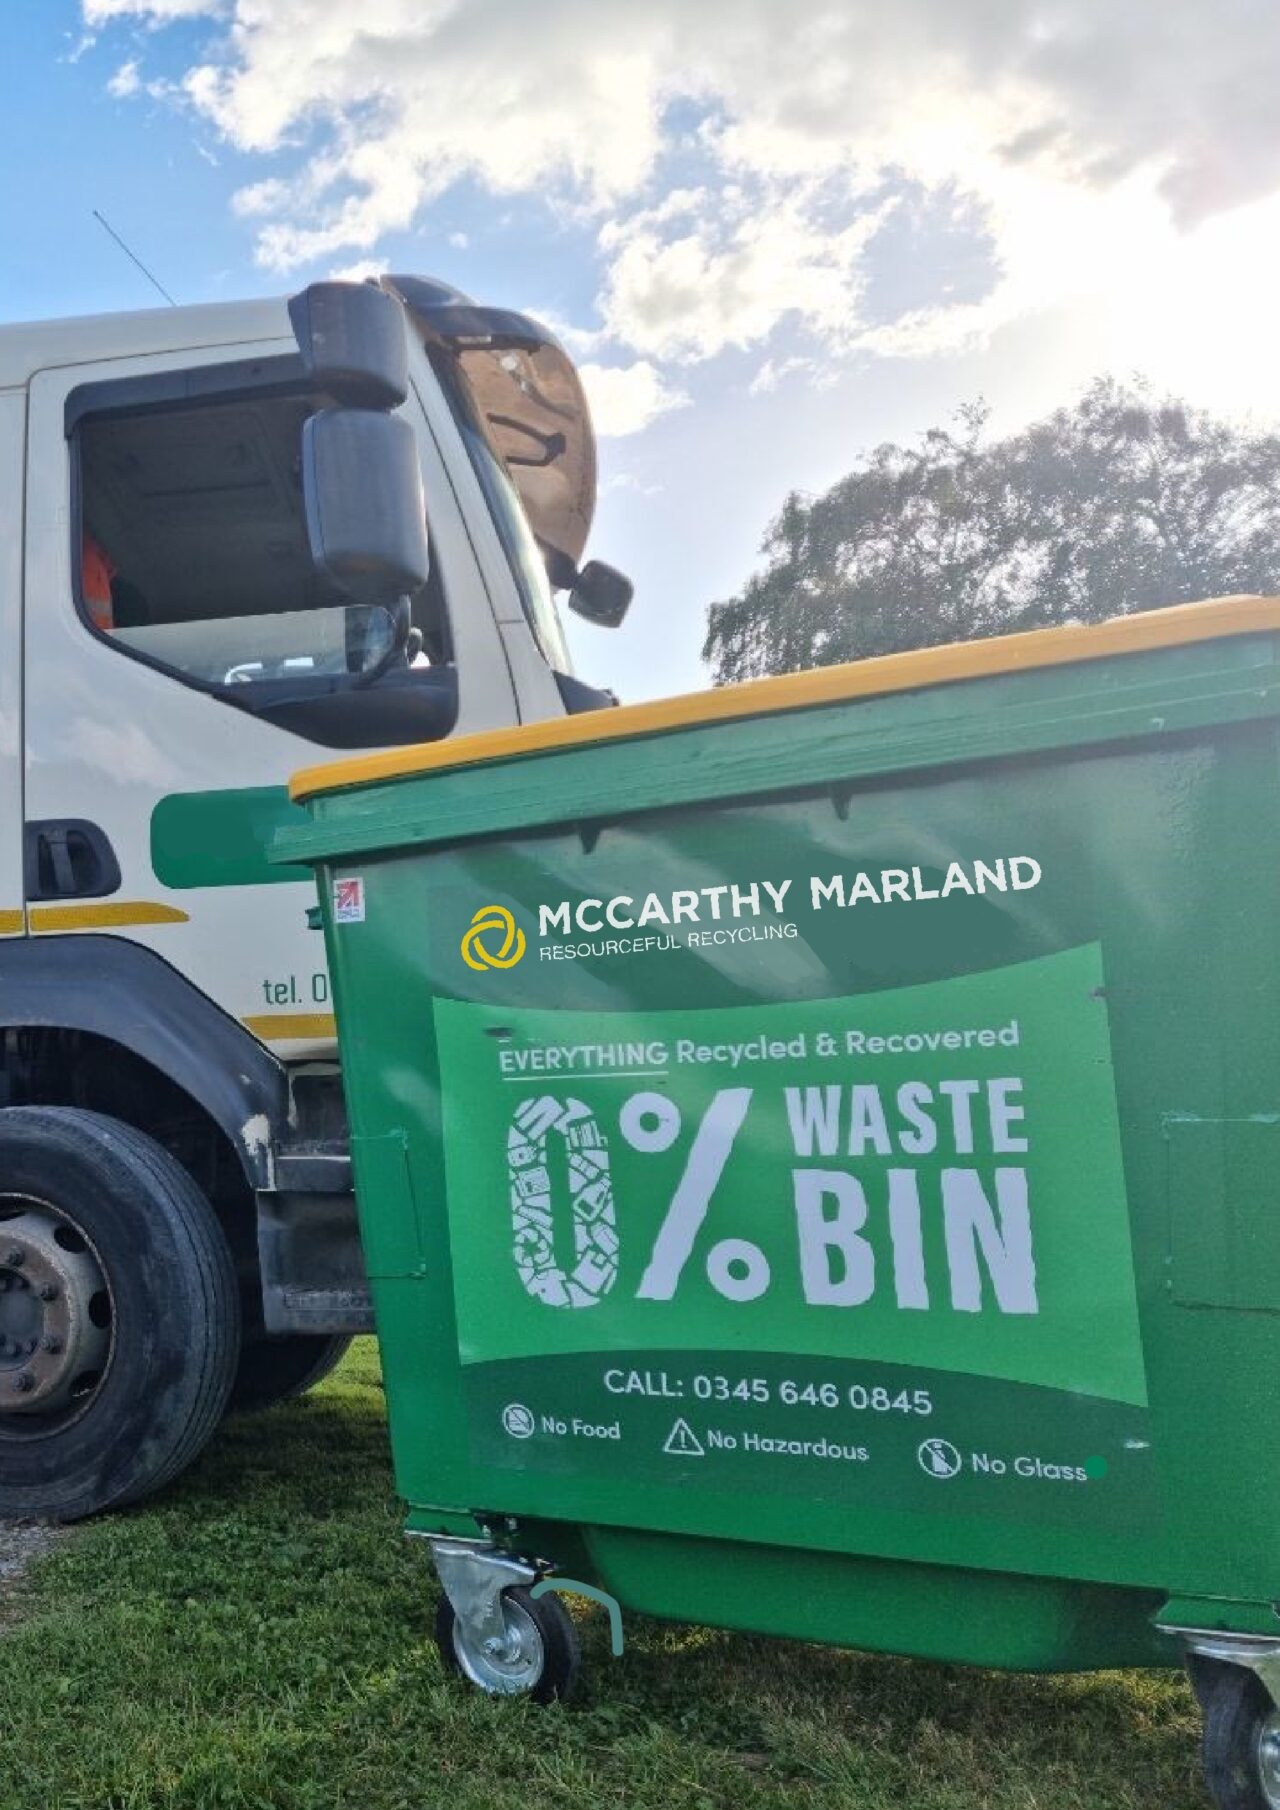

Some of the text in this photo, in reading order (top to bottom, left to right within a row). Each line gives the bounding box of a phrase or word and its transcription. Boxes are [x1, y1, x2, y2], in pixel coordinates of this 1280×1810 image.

[538, 856, 1042, 937] MCCARTHY MARLAND
[539, 923, 798, 961] RESOURCEFUL RECYCLING
[262, 974, 302, 1005] tel.
[499, 1020, 1020, 1073] EVERYTHING Recycled & Recovered
[784, 1077, 1030, 1157] WASTE
[791, 1166, 1039, 1315] BIN
[603, 1369, 933, 1415] CALL: 0345 646 0845
[541, 1416, 621, 1440] No Food
[707, 1429, 870, 1462] No Hazardous
[971, 1453, 1089, 1482] No Glass
